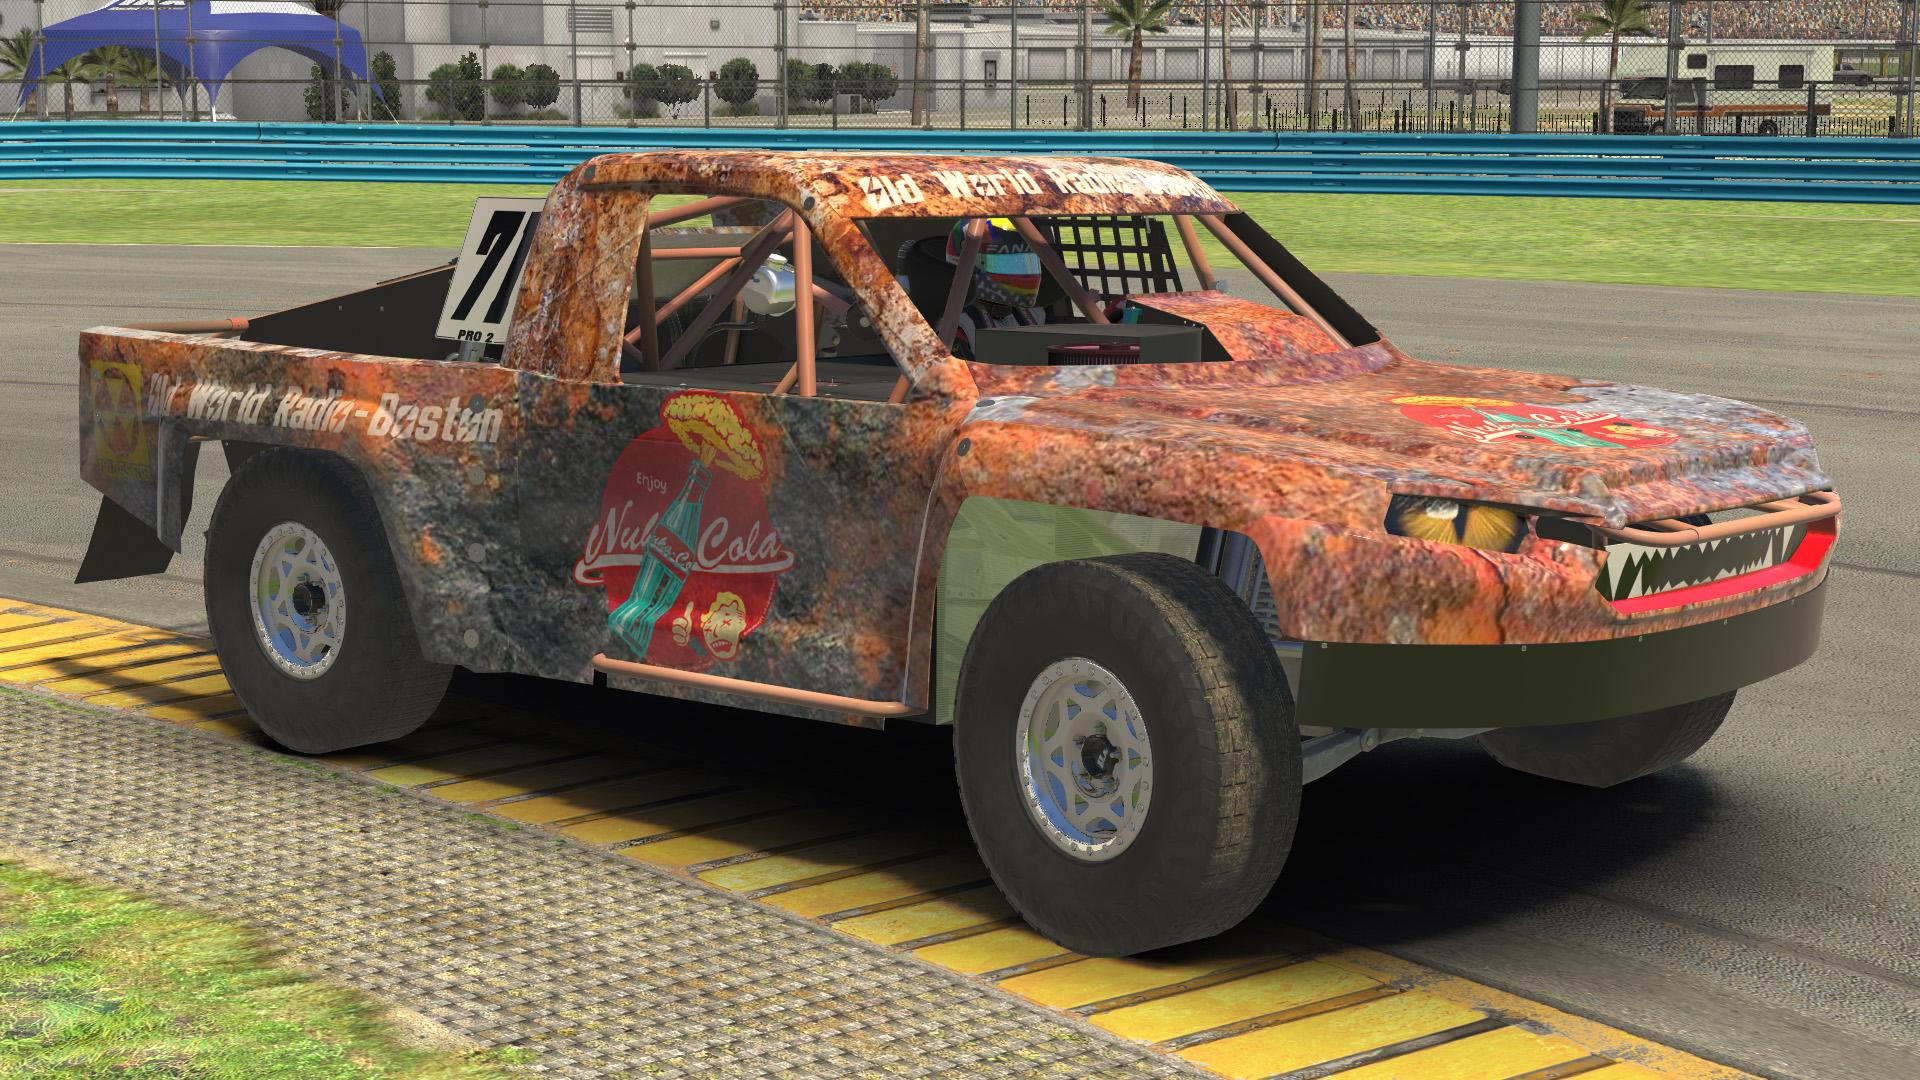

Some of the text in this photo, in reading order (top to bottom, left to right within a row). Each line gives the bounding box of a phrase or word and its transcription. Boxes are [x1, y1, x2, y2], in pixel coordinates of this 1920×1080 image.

[858, 173, 925, 211] Old
[931, 169, 1043, 199] World
[457, 329, 494, 344] PRO 2
[187, 378, 273, 425] World
[273, 385, 504, 444] Radio-Boston
[636, 471, 668, 495] Enjoy
[696, 516, 782, 568] Cola
